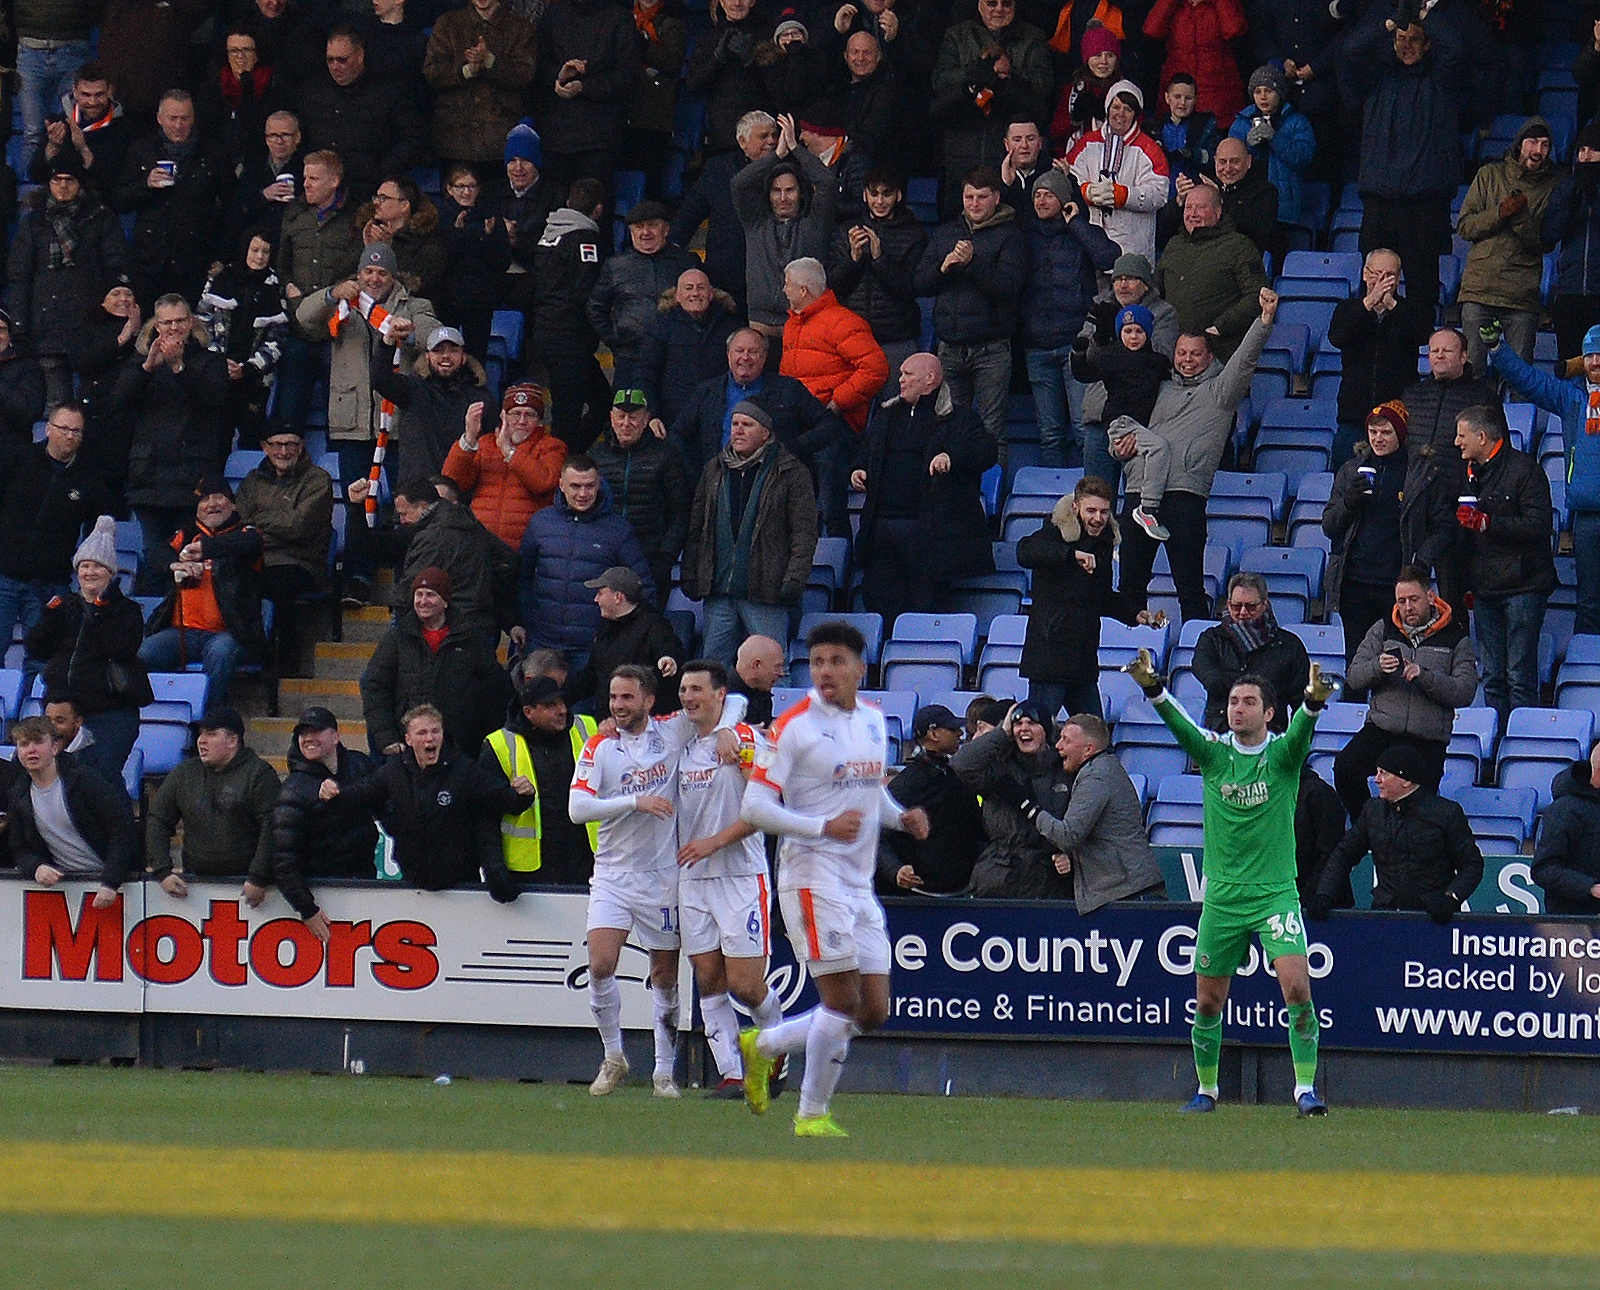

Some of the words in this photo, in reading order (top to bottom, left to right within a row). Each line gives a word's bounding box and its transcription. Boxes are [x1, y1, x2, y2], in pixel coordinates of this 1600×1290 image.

[1237, 781, 1268, 798] STAR
[746, 910, 760, 935] 6
[1267, 910, 1301, 940] 36
[22, 889, 440, 991] Motors
[941, 921, 1145, 987] County
[1451, 927, 1600, 959] Insurance
[1403, 961, 1516, 992] Backed
[1528, 964, 1565, 998] by
[992, 993, 1014, 1021] &
[1027, 994, 1170, 1025] Financial
